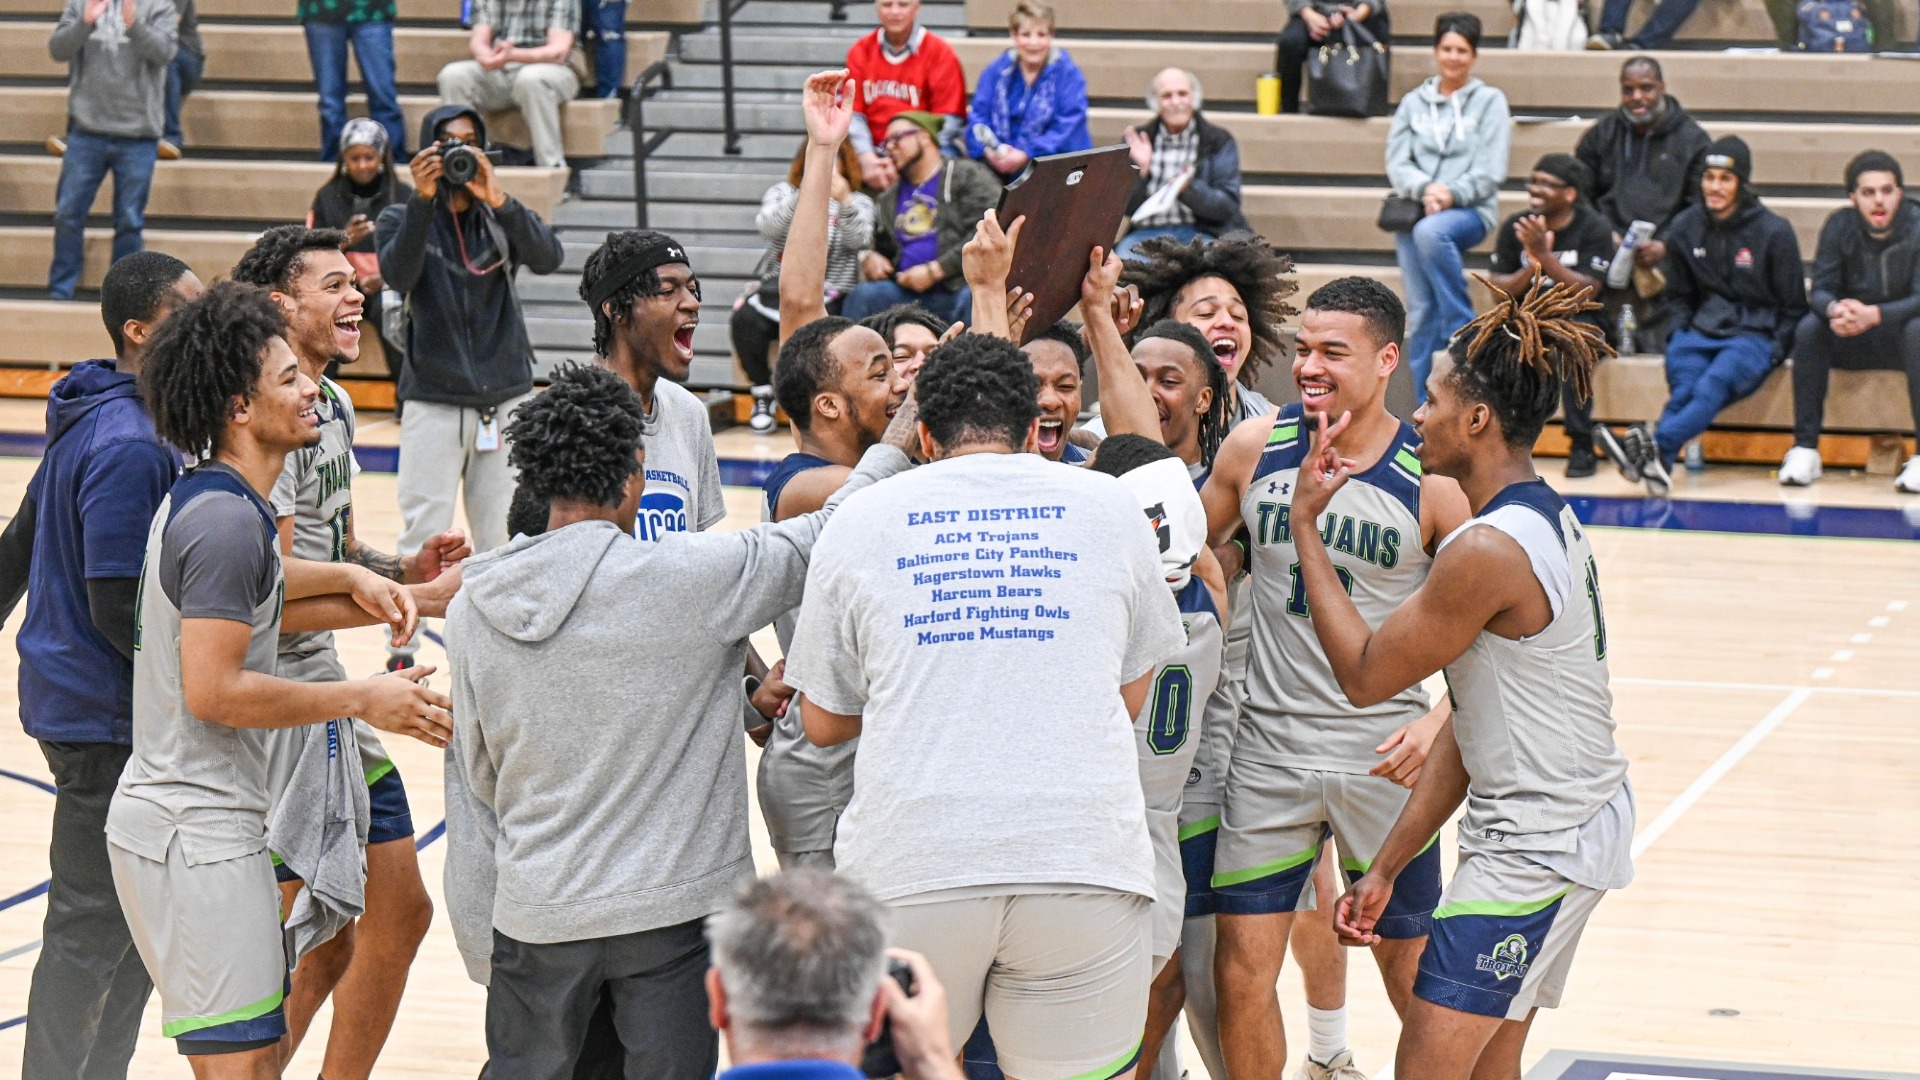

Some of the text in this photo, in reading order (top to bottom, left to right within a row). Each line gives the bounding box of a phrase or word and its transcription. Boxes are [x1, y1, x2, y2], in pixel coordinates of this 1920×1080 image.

[645, 469, 690, 492] ASKETBALL
[907, 506, 1066, 526] EAST DISTRICT
[934, 531, 1039, 545] ACM Trojans
[1257, 501, 1401, 570] TRJANS
[896, 546, 1078, 570] Baltimore City Panthers
[913, 564, 1062, 586] Hagerstown Hawks
[931, 585, 1043, 602] Harcum Bears
[903, 604, 1070, 628] Harford Fighting Owls
[917, 626, 1055, 646] Monroe Mustangs
[1146, 664, 1193, 755] 0
